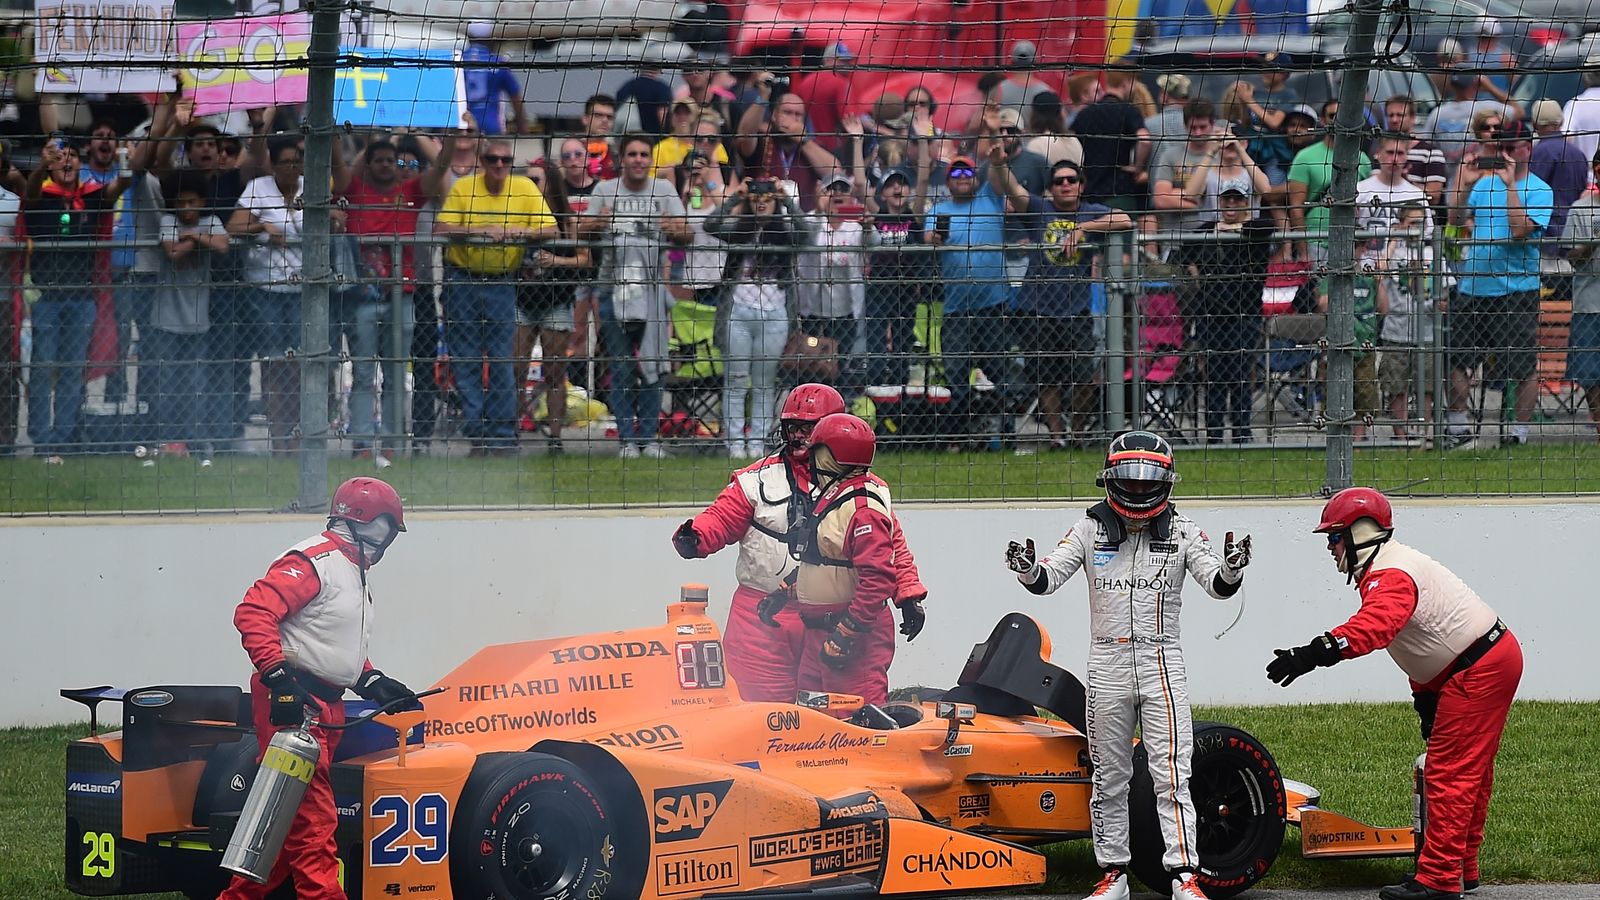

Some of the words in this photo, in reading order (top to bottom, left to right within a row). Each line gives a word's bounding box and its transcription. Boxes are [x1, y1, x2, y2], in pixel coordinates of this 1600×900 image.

[187, 25, 287, 84] GO
[1125, 511, 1149, 519] kimoa
[1093, 555, 1111, 565] SAP
[1151, 556, 1176, 566] Hilon
[1093, 577, 1174, 591] CHANDON
[549, 641, 671, 665] HONDA
[459, 678, 560, 703] RICHARD
[568, 672, 634, 693] MILLE
[671, 697, 705, 706] MICHAEL
[1087, 670, 1097, 740] ANDRETTI
[423, 707, 597, 737] #RaceOfTwoWorlds
[767, 711, 800, 731] CNN
[581, 724, 679, 748] ation
[767, 734, 827, 754] Fernando
[828, 732, 871, 751] Alonso
[949, 745, 971, 755] Castrol
[796, 757, 849, 769] @McLarenIndy
[1229, 736, 1283, 816] Firestone
[68, 781, 115, 794] McLaren
[490, 773, 566, 825] FIREHAWK
[961, 796, 988, 807] GREAT
[655, 792, 717, 834] SAP
[827, 802, 878, 820] McLaren
[370, 792, 449, 867] 29
[1309, 831, 1366, 844] CROWDSTRIKE
[83, 831, 115, 878] 29
[754, 835, 822, 860] WORLD'S
[815, 854, 841, 871] #WFG
[903, 849, 1013, 874] CHANDON
[664, 859, 733, 887] Hilton
[408, 884, 436, 893] verizon
